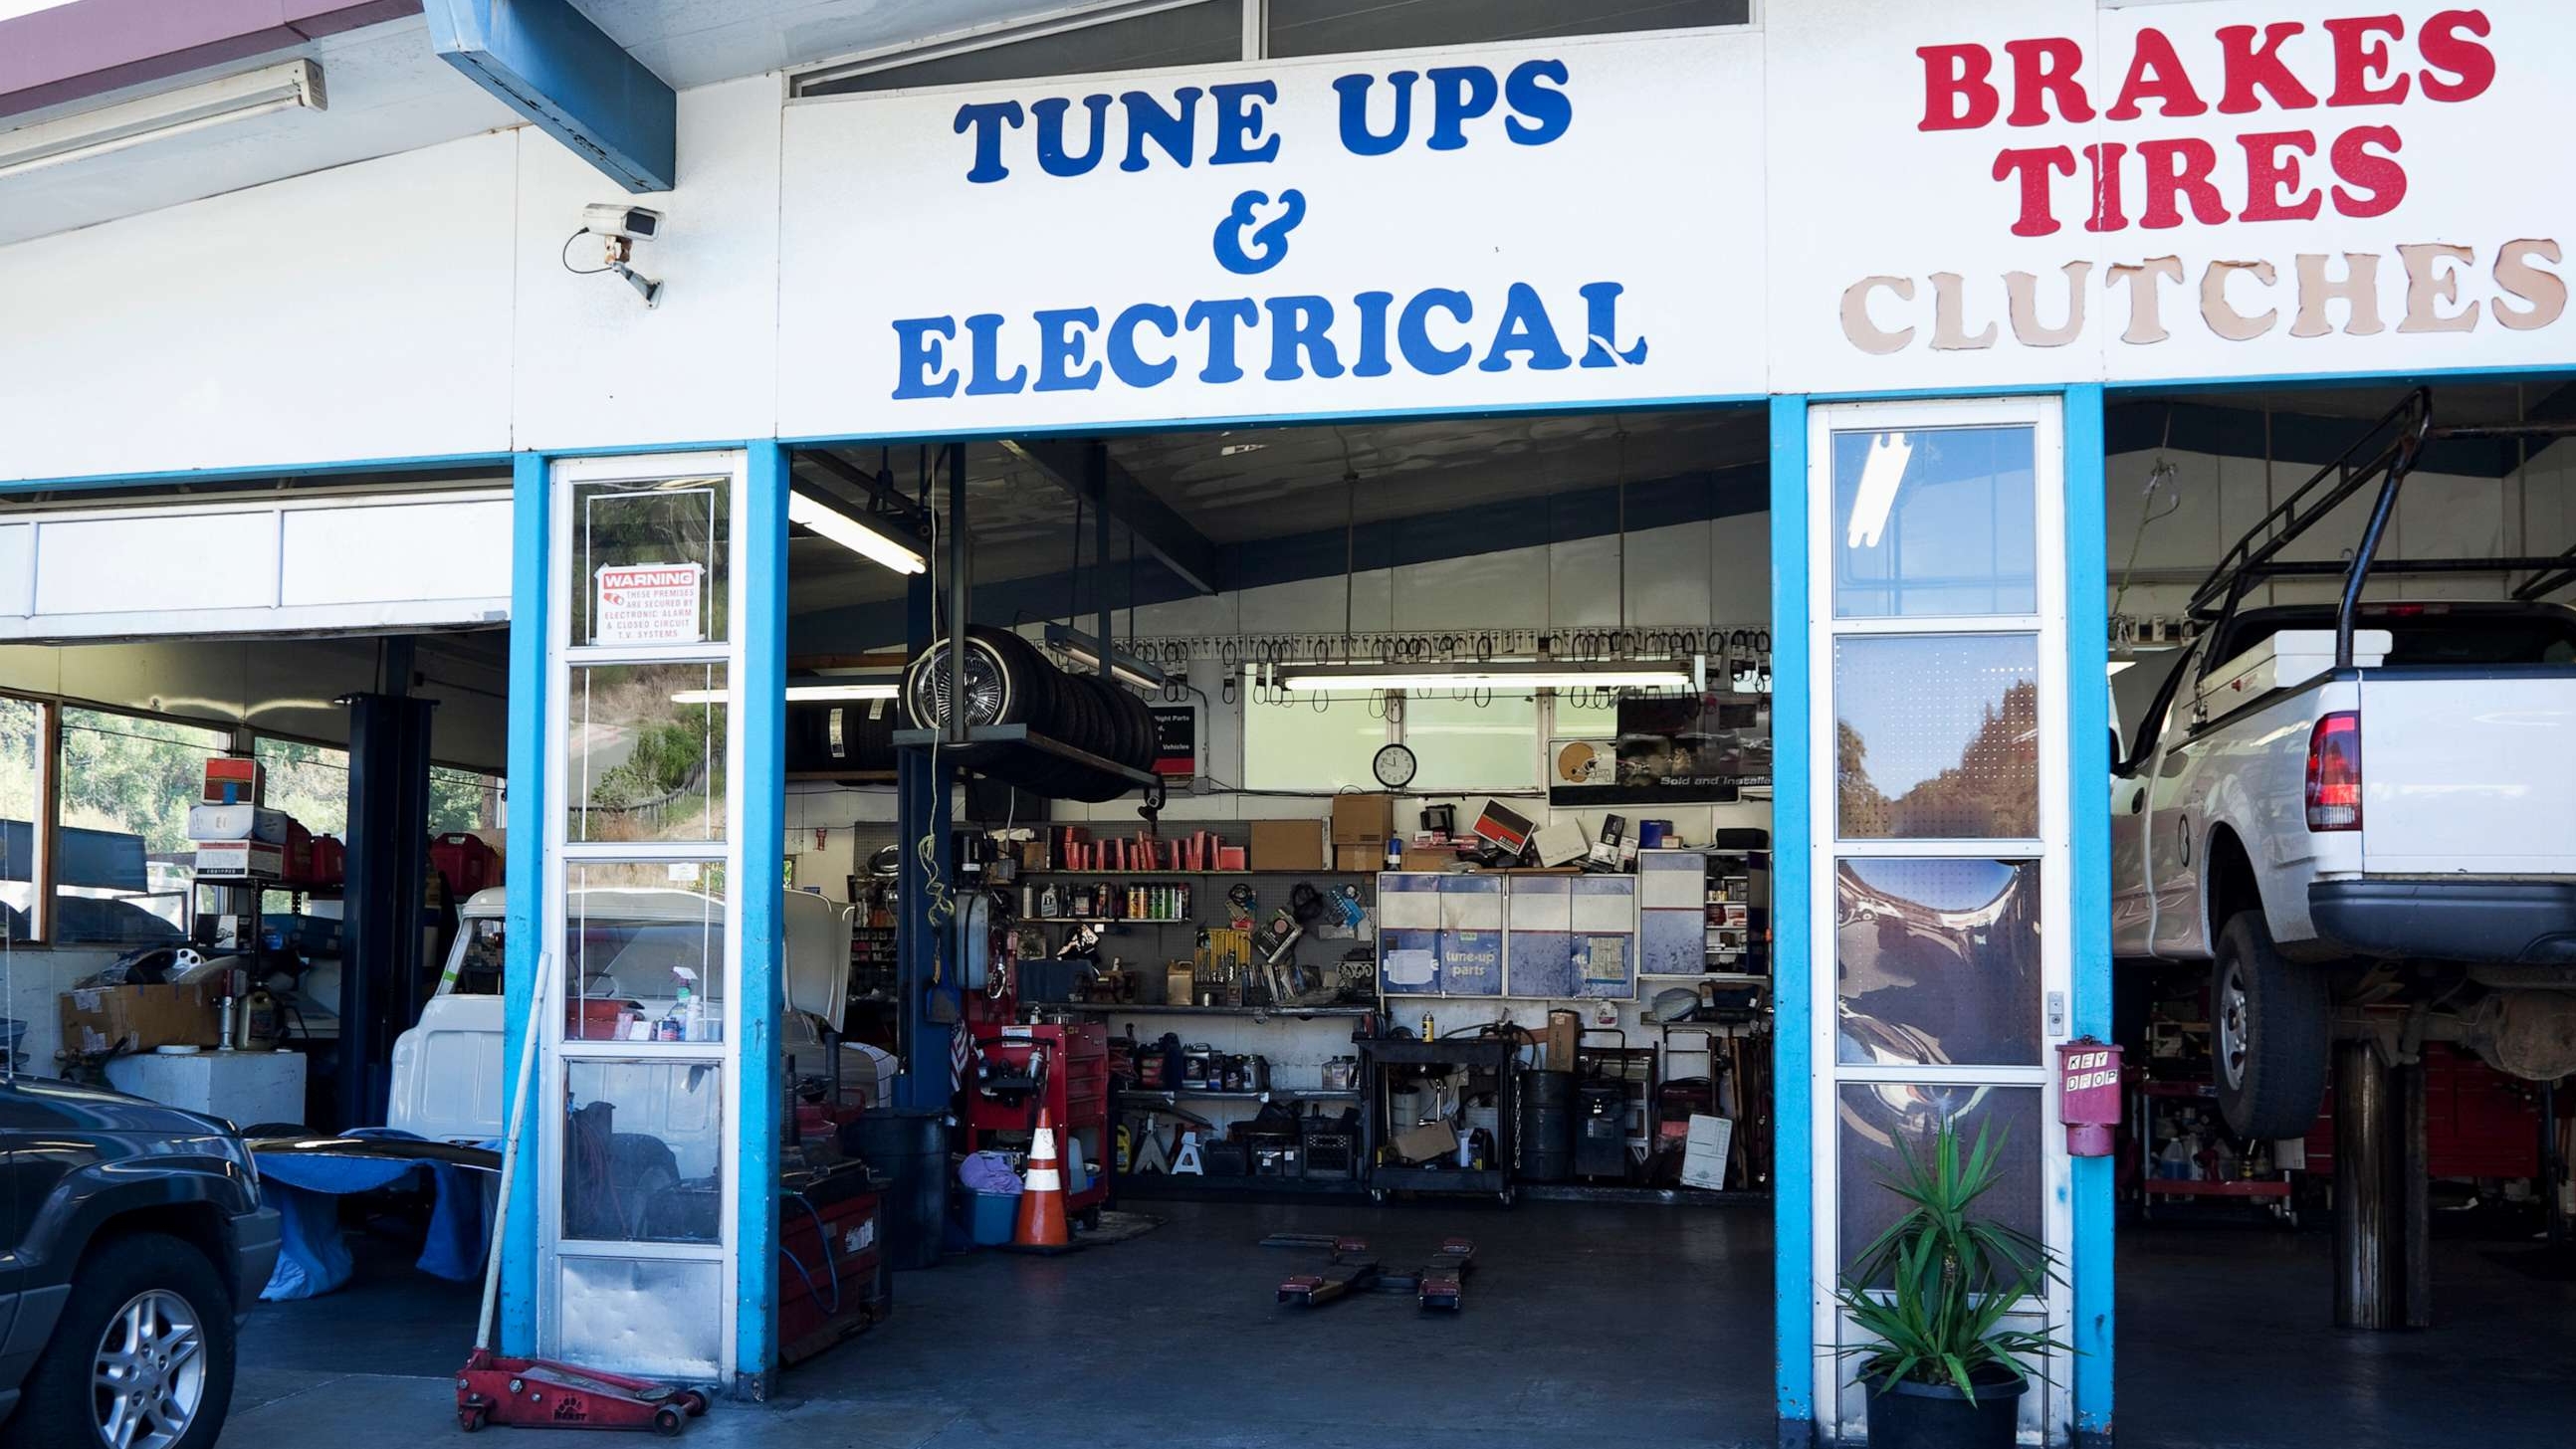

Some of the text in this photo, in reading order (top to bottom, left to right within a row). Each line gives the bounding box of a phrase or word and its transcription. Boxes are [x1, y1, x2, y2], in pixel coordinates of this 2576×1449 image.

[1917, 10, 2495, 130] BRAKES
[955, 60, 1572, 183] TUNE UPS
[1993, 125, 2407, 237] TIRES
[1213, 189, 1306, 274] &
[1839, 239, 2567, 355] CLUTCHES
[892, 283, 1647, 399] ELECTRICAL
[605, 572, 693, 587] WARNING
[645, 599, 680, 608] SECURED
[605, 608, 692, 620] ELECTRONIC ALARM
[617, 620, 649, 629] CLOSED
[654, 619, 690, 628] CIRCUIT
[1660, 776, 1690, 785] Sold
[1694, 776, 1719, 785] and
[1445, 950, 1495, 963] tune-up
[1451, 965, 1485, 977] parts
[2069, 1053, 2106, 1069] KEY
[2068, 1070, 2116, 1091] DROP
